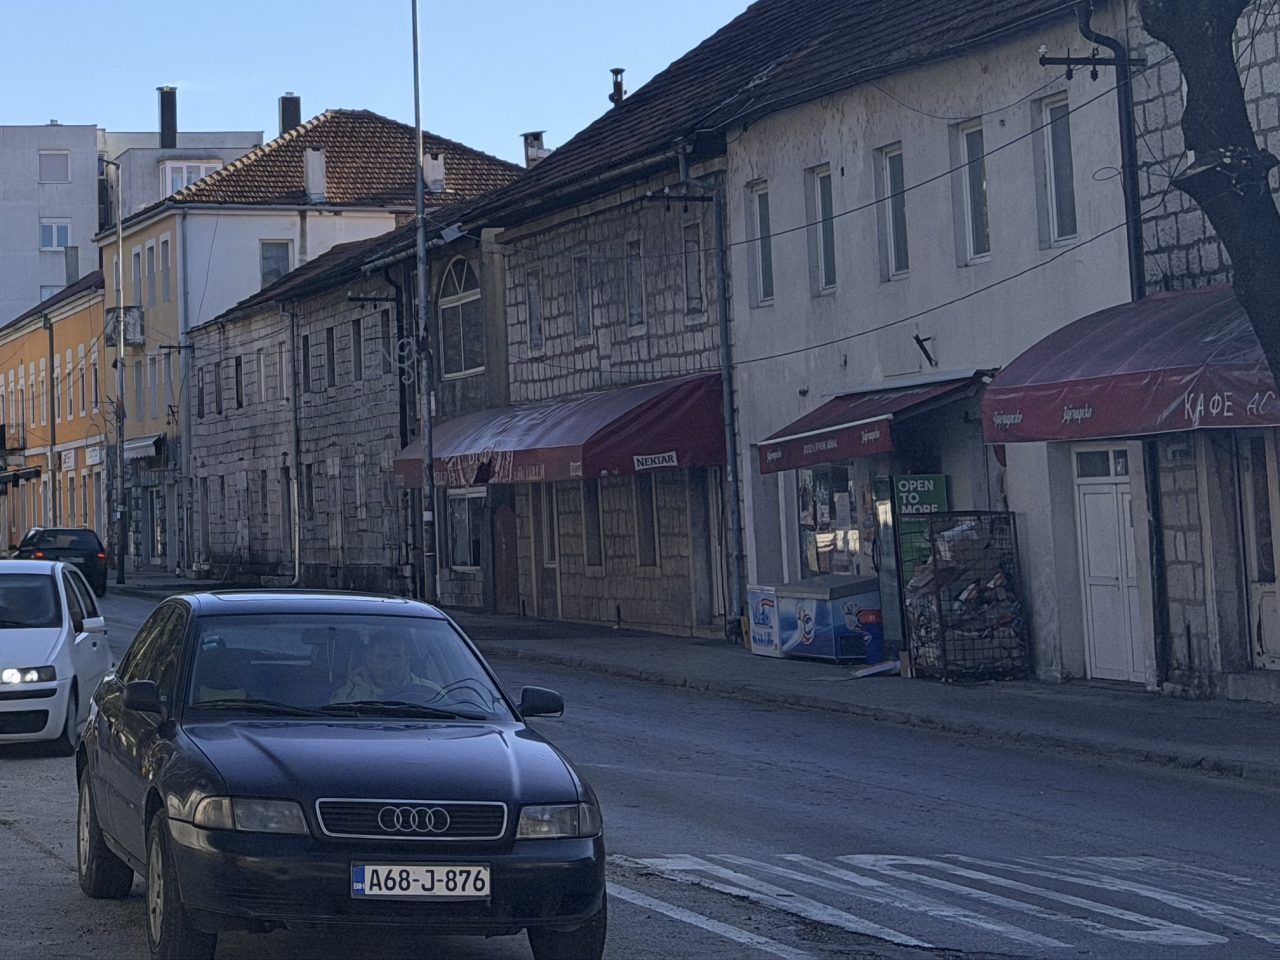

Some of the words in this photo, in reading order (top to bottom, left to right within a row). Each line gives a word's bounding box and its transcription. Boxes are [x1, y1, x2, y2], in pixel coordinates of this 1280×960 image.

[1184, 392, 1234, 420] КАФЕ
[636, 454, 675, 468] NEKTAR
[898, 479, 934, 492] OPEN
[898, 492, 920, 504] TO
[368, 868, 487, 893] A68-J-876
